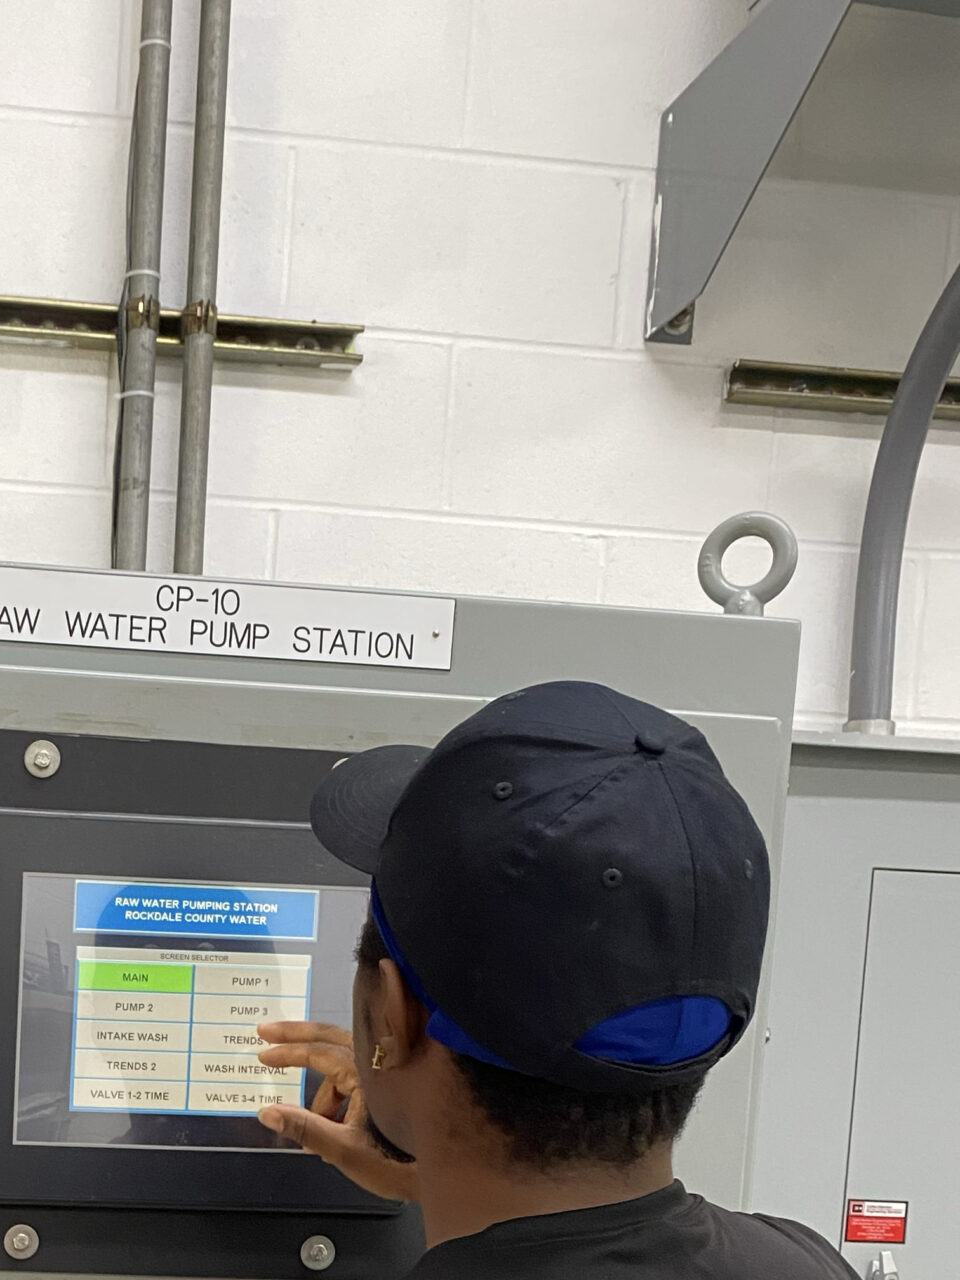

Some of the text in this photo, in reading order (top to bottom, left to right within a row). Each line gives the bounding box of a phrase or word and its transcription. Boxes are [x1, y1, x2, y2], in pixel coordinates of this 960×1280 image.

[156, 585, 241, 616] CP-10
[64, 611, 167, 644] WATER
[190, 620, 270, 650] PUMP
[292, 627, 415, 660] STATION
[115, 898, 278, 913] RAW WATER PUMPING STATION
[125, 911, 267, 925] ROCKDALE COUNTY WATER
[191, 954, 229, 962] SELECTOR
[122, 973, 149, 983] MAIN
[232, 977, 269, 986] PUMP 1
[115, 1003, 153, 1012] PUMP 2
[230, 1006, 268, 1016] PUMP 3
[97, 1032, 168, 1042] INTAKE WASH
[223, 1035, 264, 1045] TRENDS
[107, 1061, 157, 1071] TRENDS 2
[204, 1064, 287, 1075] WASH INTERVAL
[90, 1090, 170, 1101] VALVE 1-2 TIME
[206, 1094, 283, 1104] VALVE 3-4 TIME
